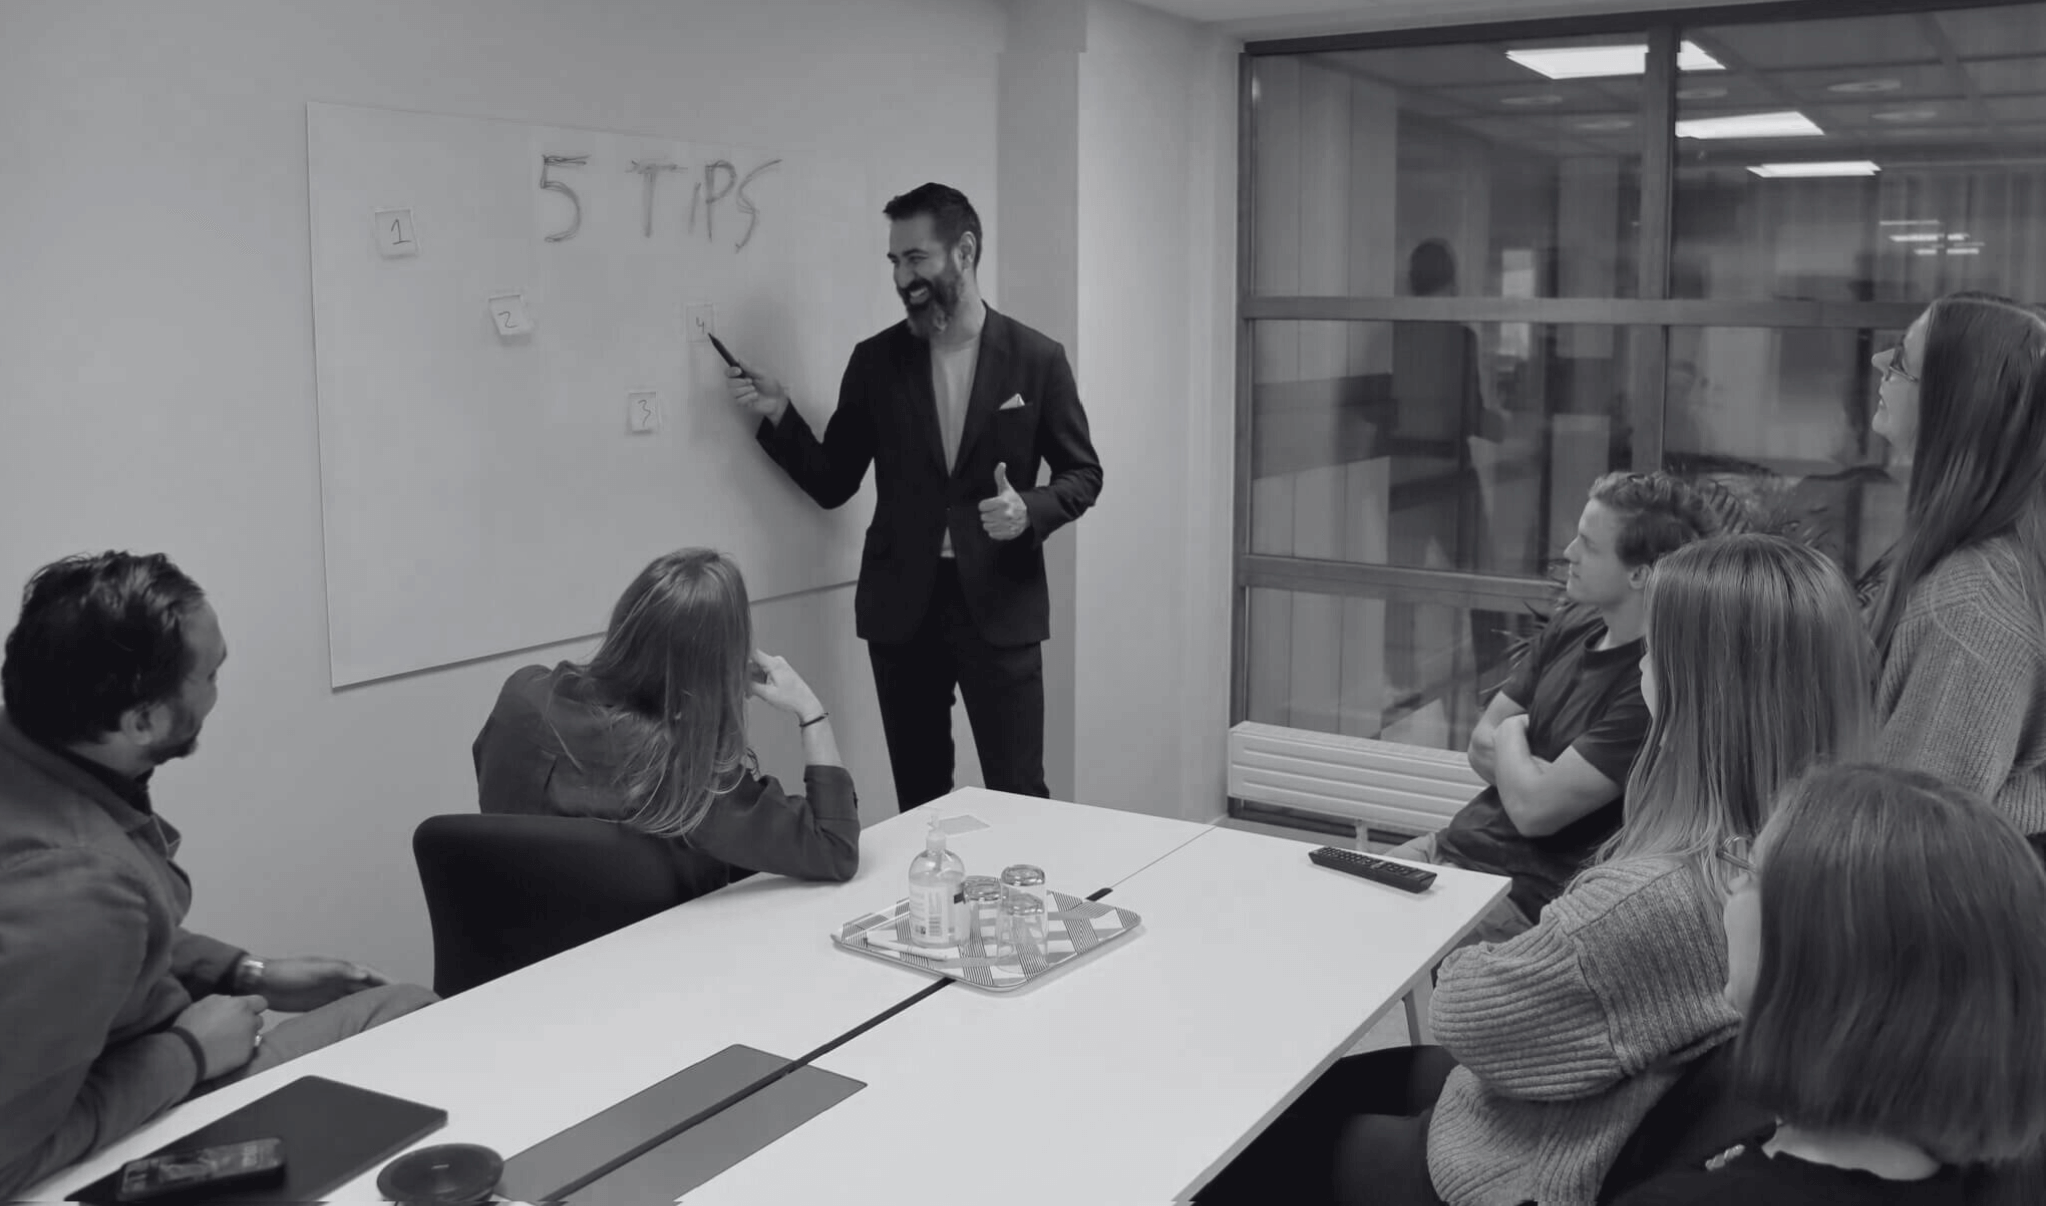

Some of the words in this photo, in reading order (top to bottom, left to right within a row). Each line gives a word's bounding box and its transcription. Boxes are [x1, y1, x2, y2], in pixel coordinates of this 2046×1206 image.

[540, 154, 591, 243] 5
[390, 218, 412, 245] 1
[497, 310, 518, 329] 2
[695, 316, 705, 335] 4
[637, 399, 652, 428] 3
